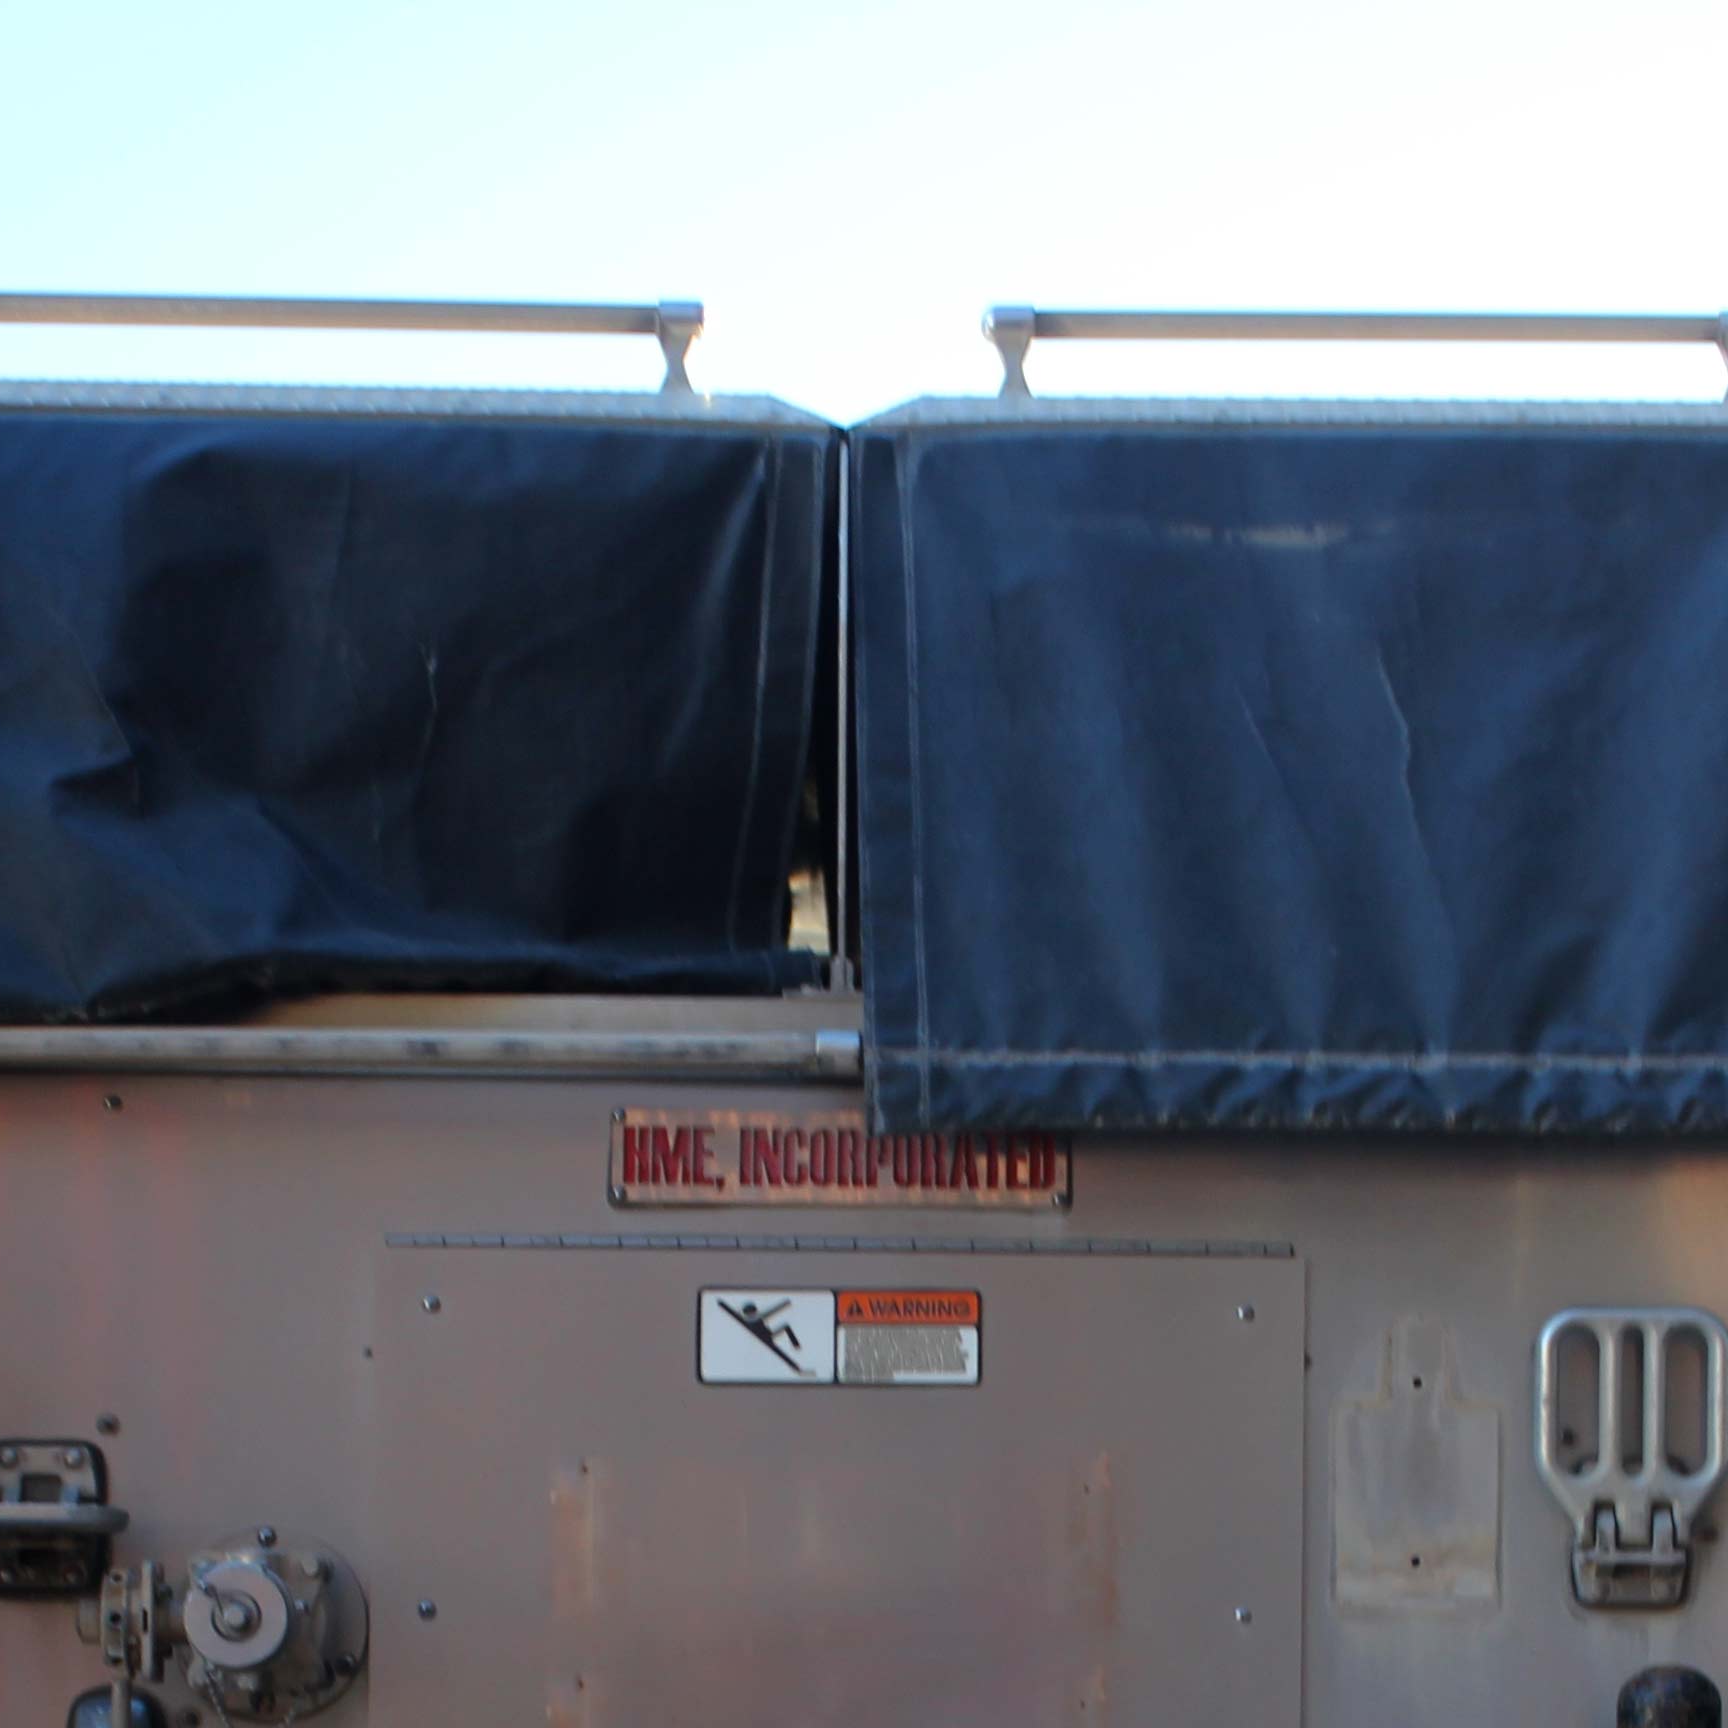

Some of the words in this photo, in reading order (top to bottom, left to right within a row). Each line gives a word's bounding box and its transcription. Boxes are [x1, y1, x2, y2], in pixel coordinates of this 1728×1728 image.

[623, 1126, 726, 1192] HME,
[739, 1126, 1056, 1190] INCORPORATED
[868, 1298, 971, 1318] WARNING
